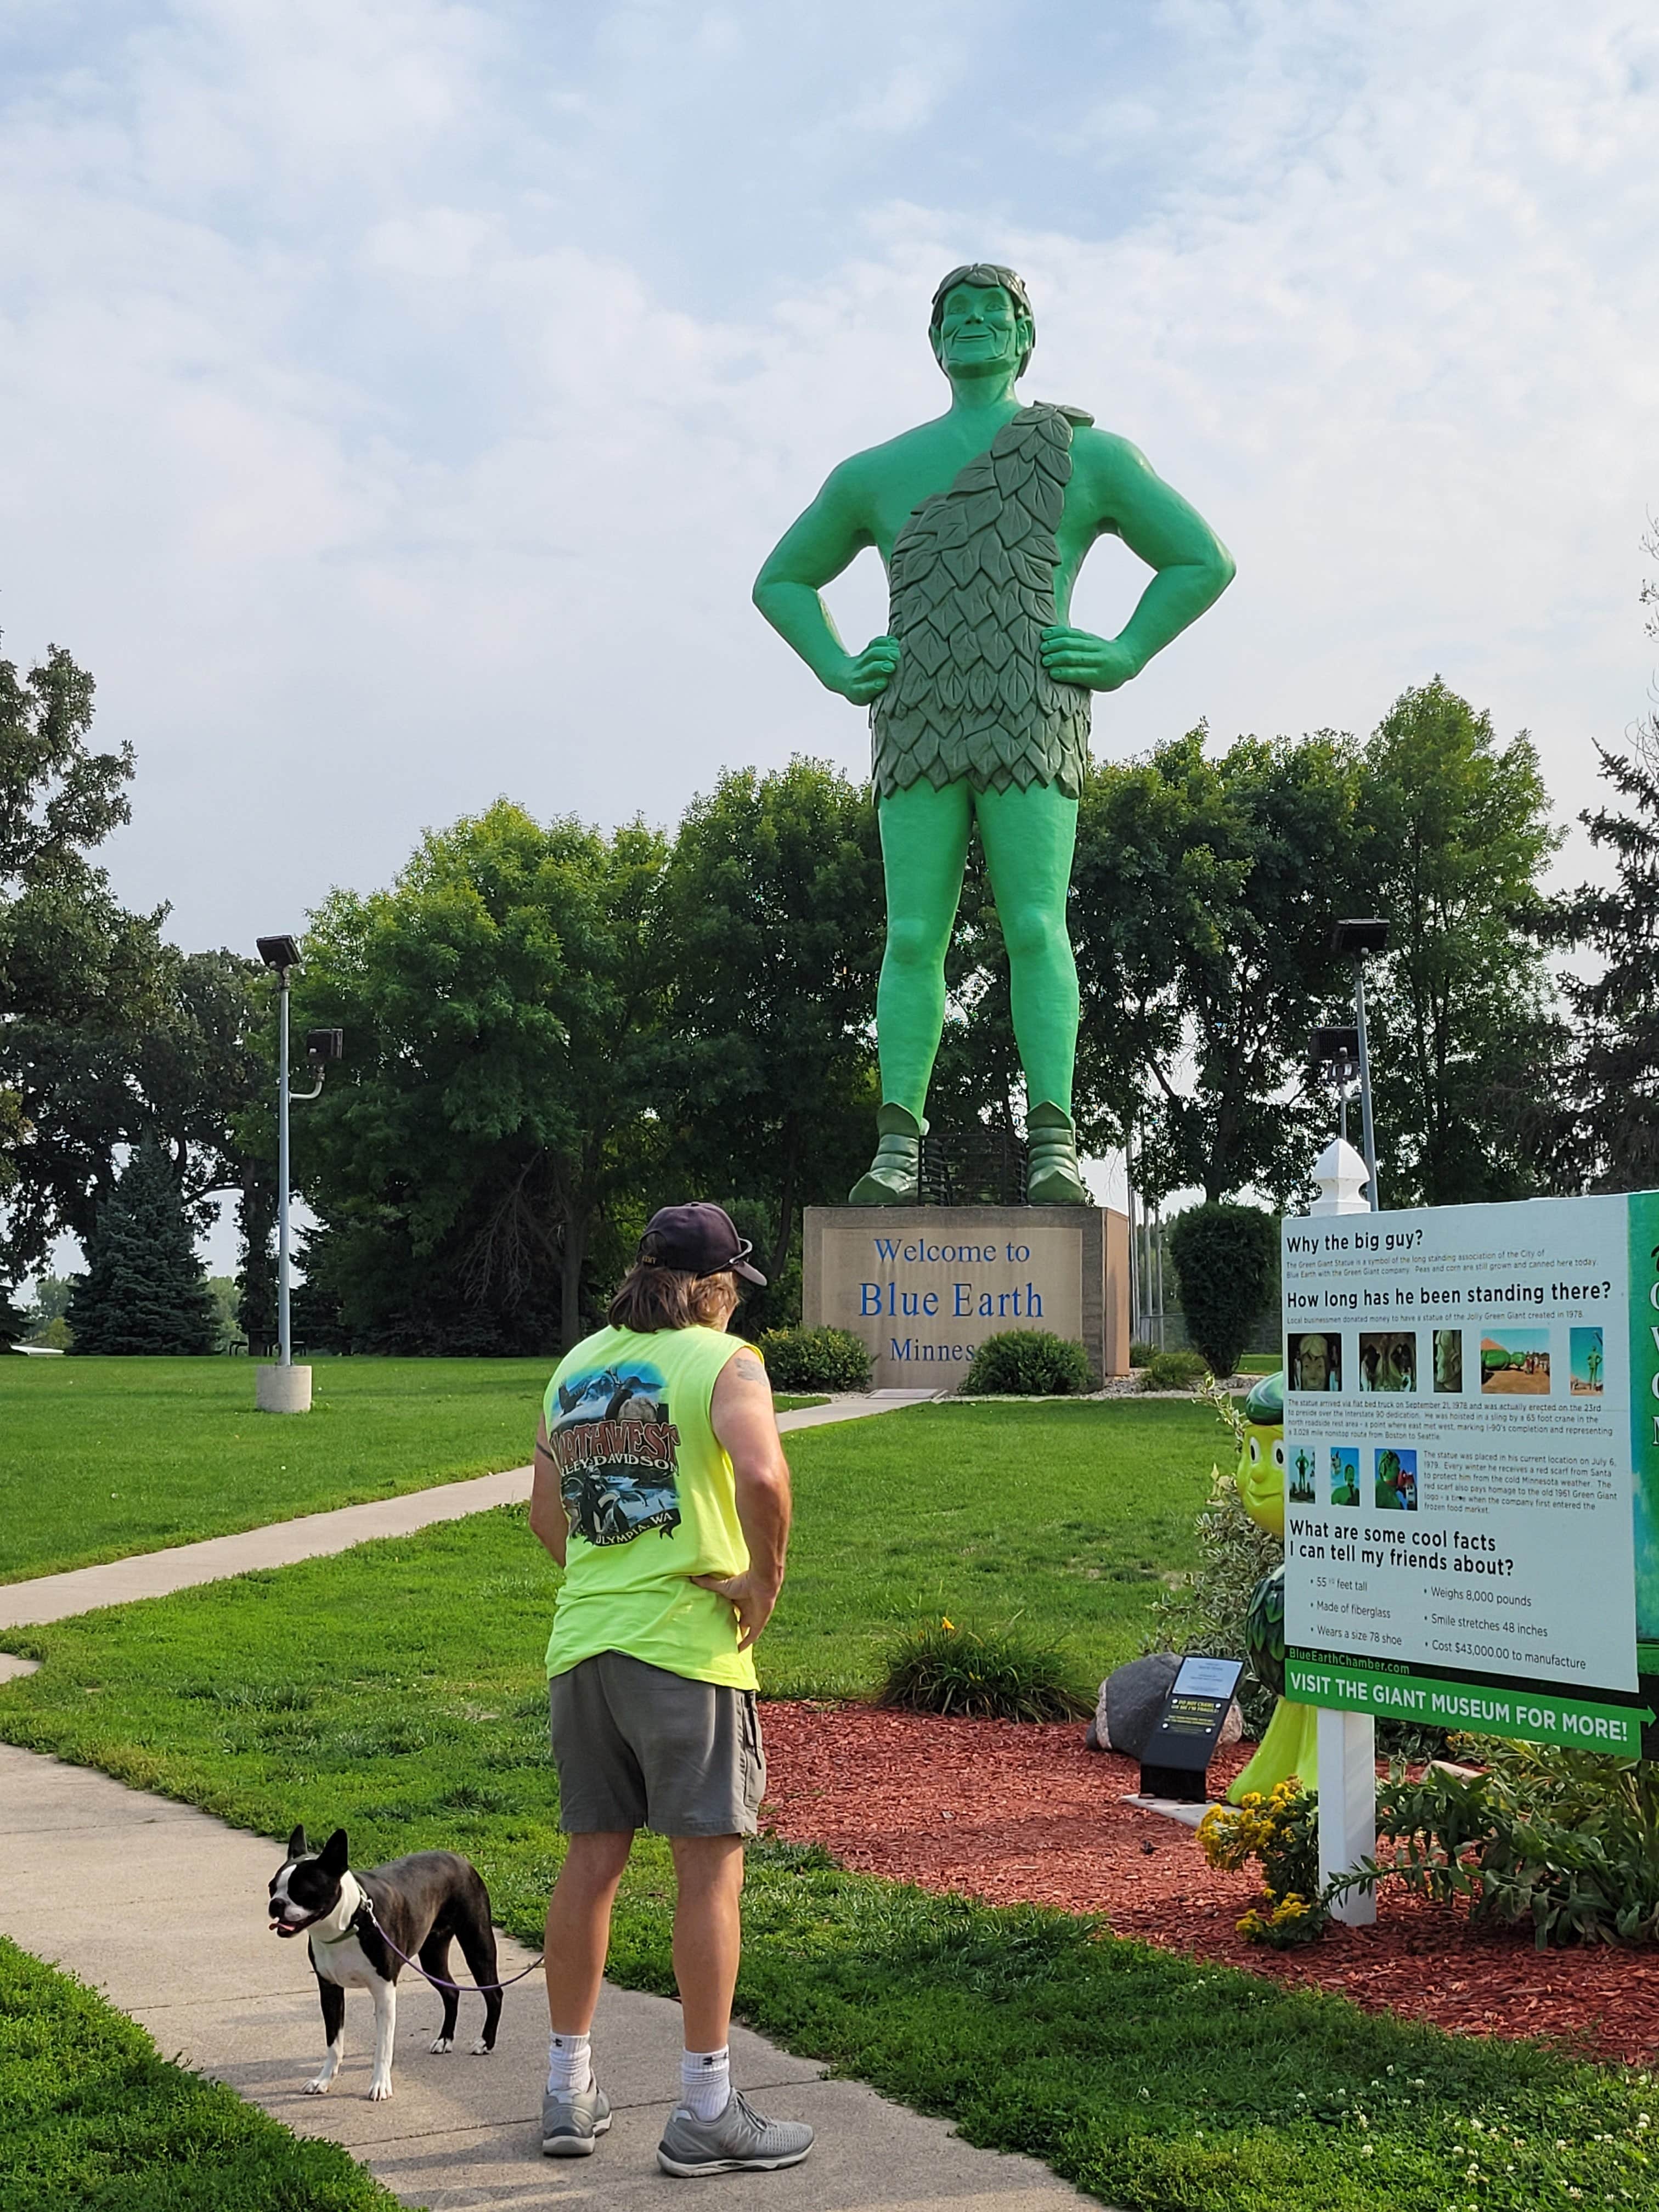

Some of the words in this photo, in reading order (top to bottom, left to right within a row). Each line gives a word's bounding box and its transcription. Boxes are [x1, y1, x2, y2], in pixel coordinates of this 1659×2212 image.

[874, 1238, 996, 1262] Welcome
[1007, 1242, 1030, 1262] to
[1286, 1235, 1319, 1254] Why
[1325, 1234, 1348, 1250] the
[1355, 1232, 1379, 1251] big
[1385, 1229, 1423, 1250] guy?
[859, 1282, 939, 1317] Blue
[952, 1282, 1043, 1317] Earth
[1287, 1292, 1319, 1308] How
[1324, 1290, 1357, 1309] long
[1364, 1289, 1389, 1306] has
[1396, 1288, 1414, 1305] he
[1420, 1287, 1460, 1304] been
[1467, 1284, 1544, 1304] standing
[1551, 1281, 1611, 1300] there?
[890, 1338, 975, 1361] Minnes
[1424, 1451, 1436, 1459] The
[1474, 1453, 1498, 1463] placed
[1548, 1457, 1578, 1465] location
[1592, 1458, 1607, 1466] July
[1444, 1462, 1463, 1472] Every
[1498, 1465, 1528, 1474] receives
[1550, 1466, 1569, 1475] scarf
[1570, 1467, 1589, 1476] from
[1590, 1468, 1612, 1477] Santa
[1432, 1473, 1457, 1482] protect
[1473, 1474, 1490, 1482] from
[1491, 1475, 1503, 1483] the
[1504, 1475, 1520, 1485] cold
[1522, 1476, 1559, 1486] Minnesota
[1597, 1480, 1611, 1488] The
[1470, 1485, 1487, 1494] pays
[1527, 1488, 1540, 1496] the
[1541, 1488, 1554, 1497] old
[1572, 1490, 1595, 1499] Green
[1596, 1492, 1617, 1500] Giant
[650, 1513, 673, 1525] WA
[1290, 1519, 1329, 1538] What
[1334, 1525, 1358, 1541] are
[1364, 1528, 1405, 1544] some
[1412, 1530, 1447, 1548] cool
[1453, 1531, 1496, 1551] facts
[1290, 1541, 1294, 1556] I
[1300, 1544, 1325, 1559] can
[1331, 1544, 1356, 1562] tell
[1362, 1549, 1384, 1568] my
[1390, 1548, 1447, 1570] friends
[1453, 1555, 1514, 1576] about?
[1317, 1577, 1327, 1587] 55
[1337, 1578, 1353, 1590] feet
[1355, 1581, 1368, 1592] tall
[1431, 1587, 1464, 1601] Weighs
[1466, 1590, 1494, 1602] 8,000
[1497, 1594, 1532, 1607] pounds
[1317, 1600, 1339, 1612] Made
[1341, 1603, 1349, 1613] of
[1351, 1604, 1391, 1619] fiberglass
[1317, 1625, 1342, 1638] Wears
[1352, 1630, 1368, 1641] size
[1369, 1632, 1380, 1643] 78
[1382, 1634, 1402, 1645] shoe
[1431, 1613, 1456, 1626] Smile
[1458, 1617, 1500, 1632] stretches
[1502, 1622, 1515, 1633] 48
[1517, 1623, 1548, 1637] inches
[1289, 1647, 1410, 1674] BlueEarthChamber.com
[1432, 1639, 1453, 1652] Cost
[1455, 1642, 1510, 1660] $43,000.00
[1512, 1651, 1522, 1661] to
[1525, 1652, 1587, 1669] manufacture
[1290, 1672, 1331, 1695] VISIT
[1335, 1679, 1368, 1701] THE
[1373, 1684, 1426, 1710] GIANT
[1432, 1693, 1509, 1723] MUSEUM
[1516, 1706, 1556, 1730] FOR
[1563, 1713, 1627, 1742] MORE!
